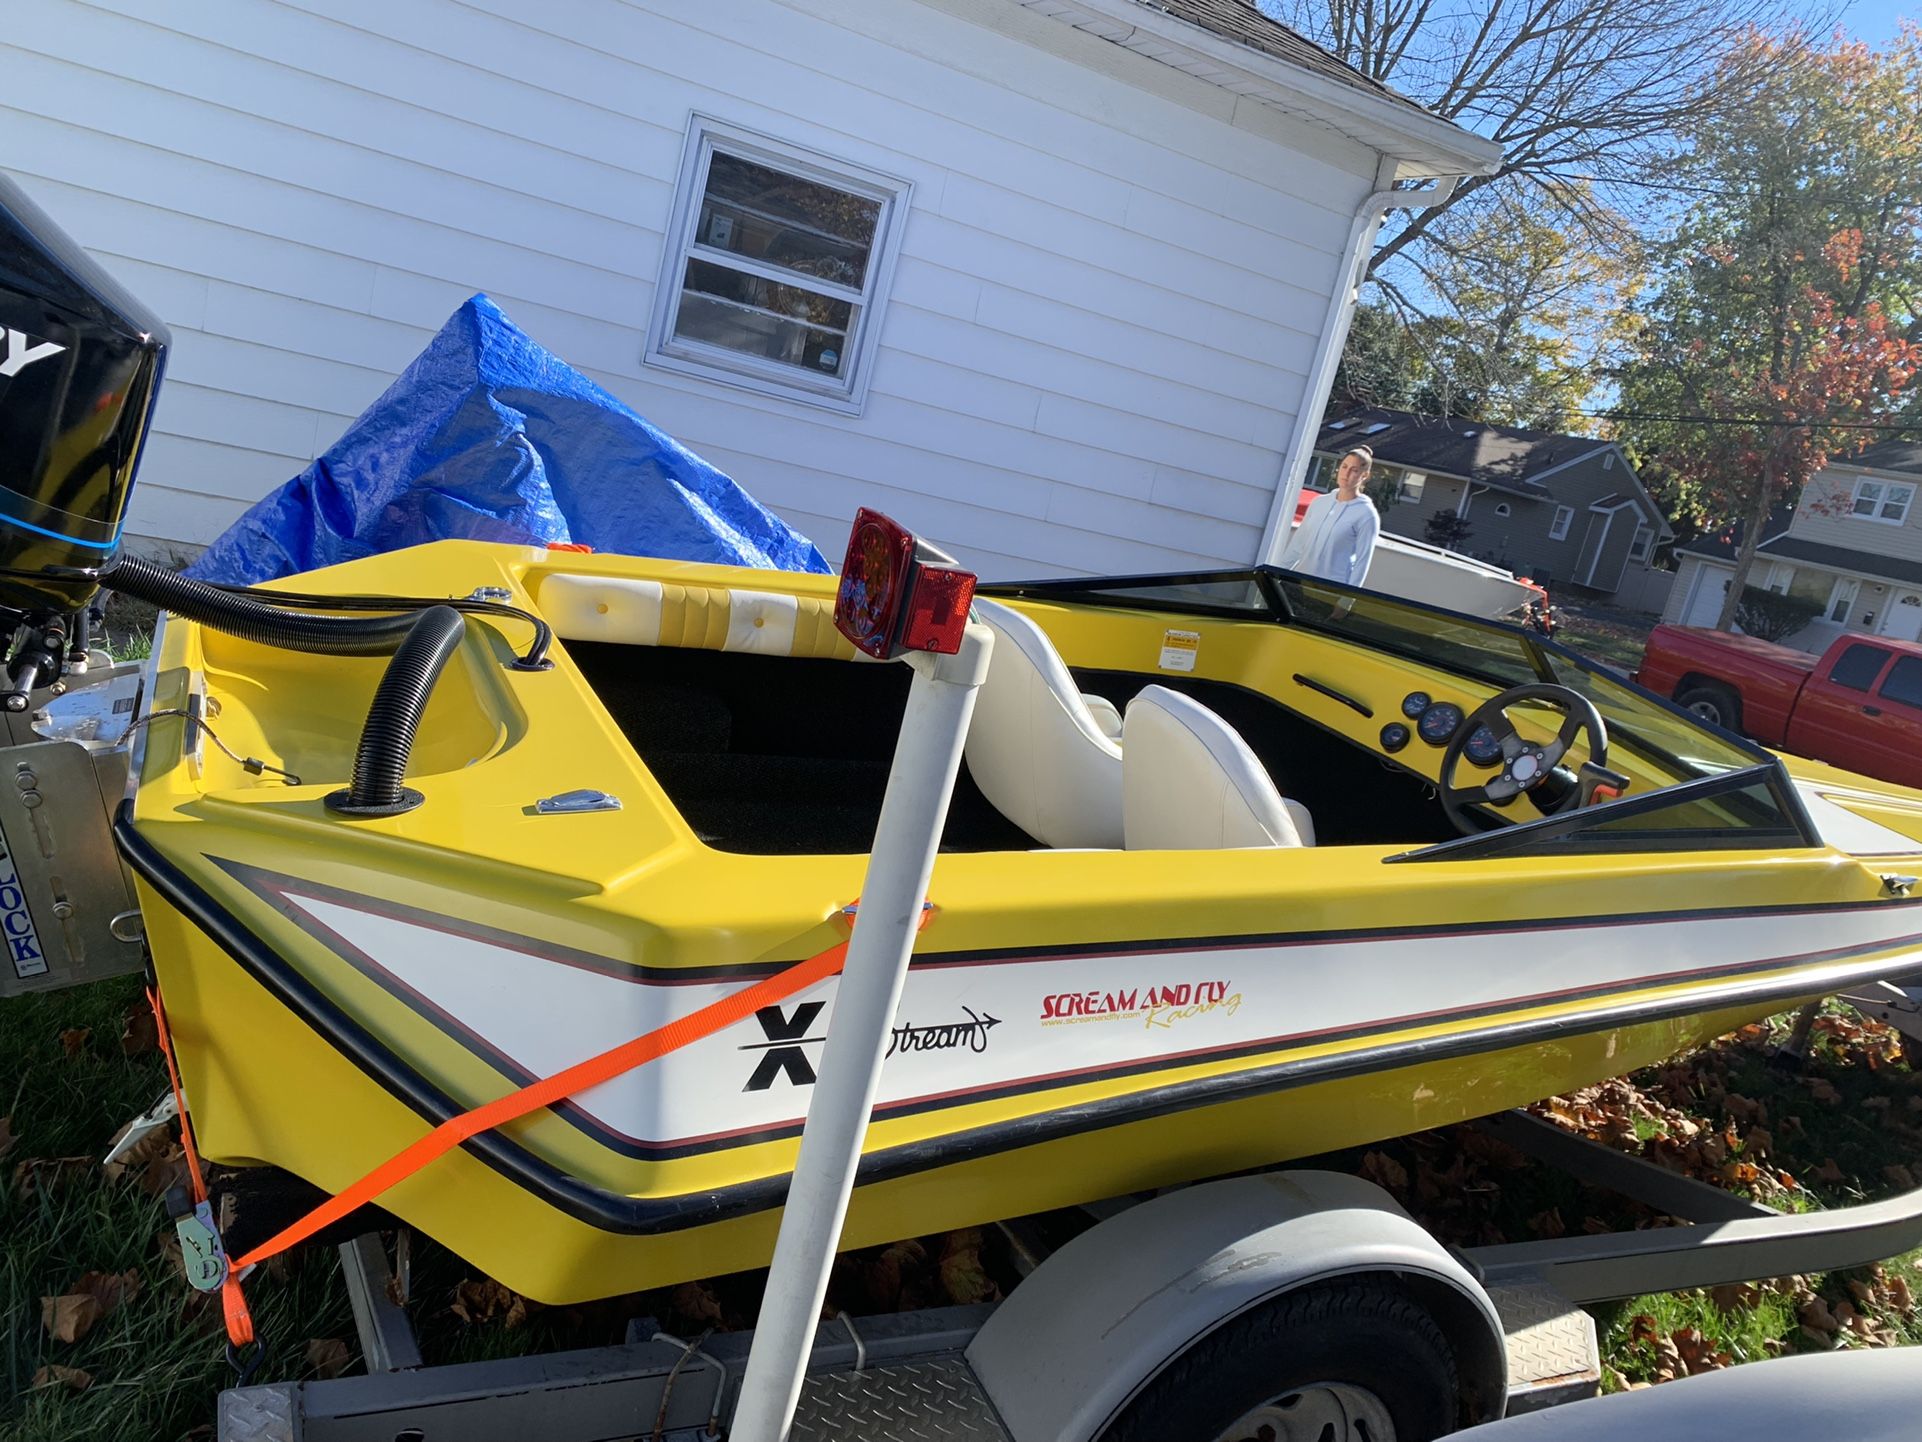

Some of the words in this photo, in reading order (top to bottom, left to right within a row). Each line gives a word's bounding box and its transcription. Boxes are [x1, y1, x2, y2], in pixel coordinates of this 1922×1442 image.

[0, 326, 67, 377] Y
[1040, 988, 1138, 1019] SCREAM
[1140, 984, 1192, 1010] AND
[1194, 980, 1231, 1005] FLY
[1144, 993, 1242, 1029] Racing
[885, 1005, 990, 1061] tream
[1040, 1011, 1141, 1028] www.screamandfly.com
